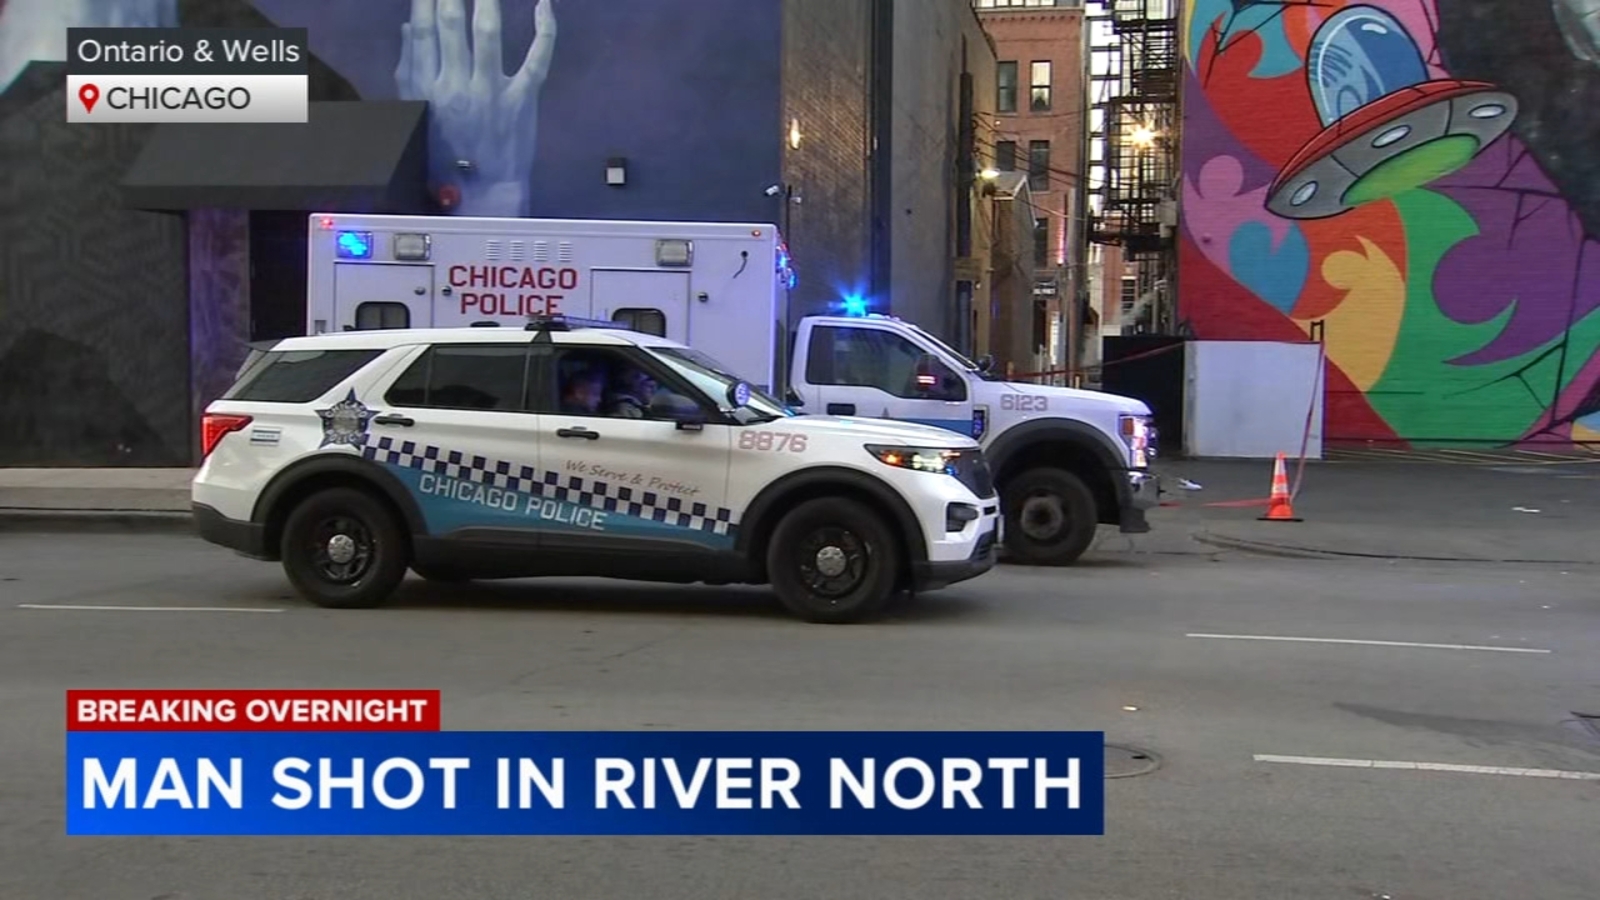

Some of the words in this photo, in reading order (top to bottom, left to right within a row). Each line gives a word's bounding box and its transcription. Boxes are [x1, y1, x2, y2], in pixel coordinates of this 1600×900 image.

[449, 265, 578, 289] CHICAGO
[461, 293, 563, 316] POLICE
[1001, 394, 1048, 411] 6123
[738, 430, 808, 452] 8876
[565, 460, 587, 473] We
[589, 465, 627, 481] Serve
[629, 473, 644, 485] &
[647, 476, 701, 496] Protect
[419, 474, 518, 512] CHICAGO
[525, 497, 608, 530] POLICE
